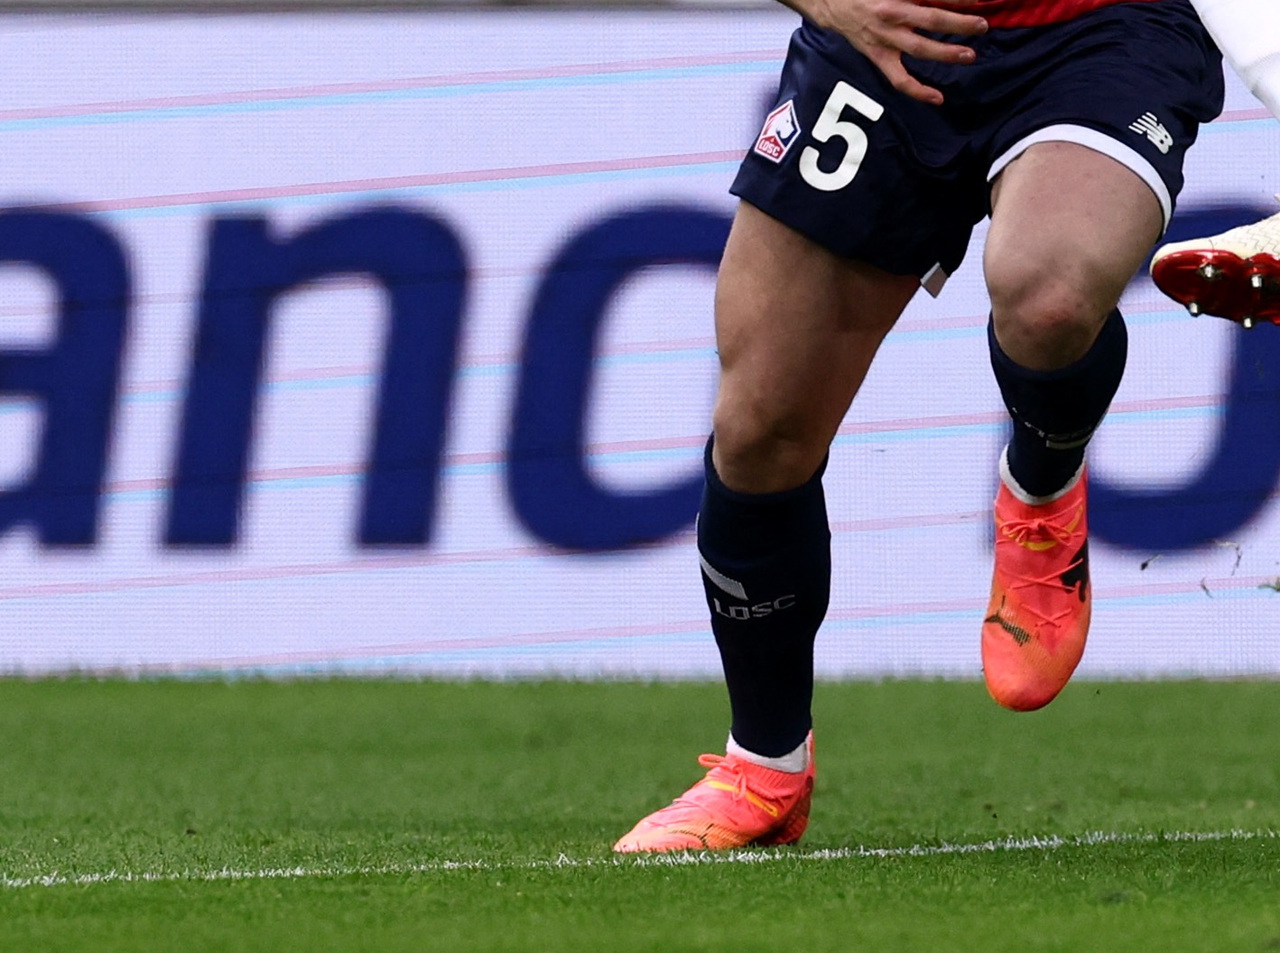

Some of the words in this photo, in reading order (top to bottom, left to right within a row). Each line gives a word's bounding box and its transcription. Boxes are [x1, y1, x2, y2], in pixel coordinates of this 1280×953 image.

[757, 139, 782, 158] LOSC
[799, 80, 885, 191] 5
[713, 594, 796, 621] LOSC
